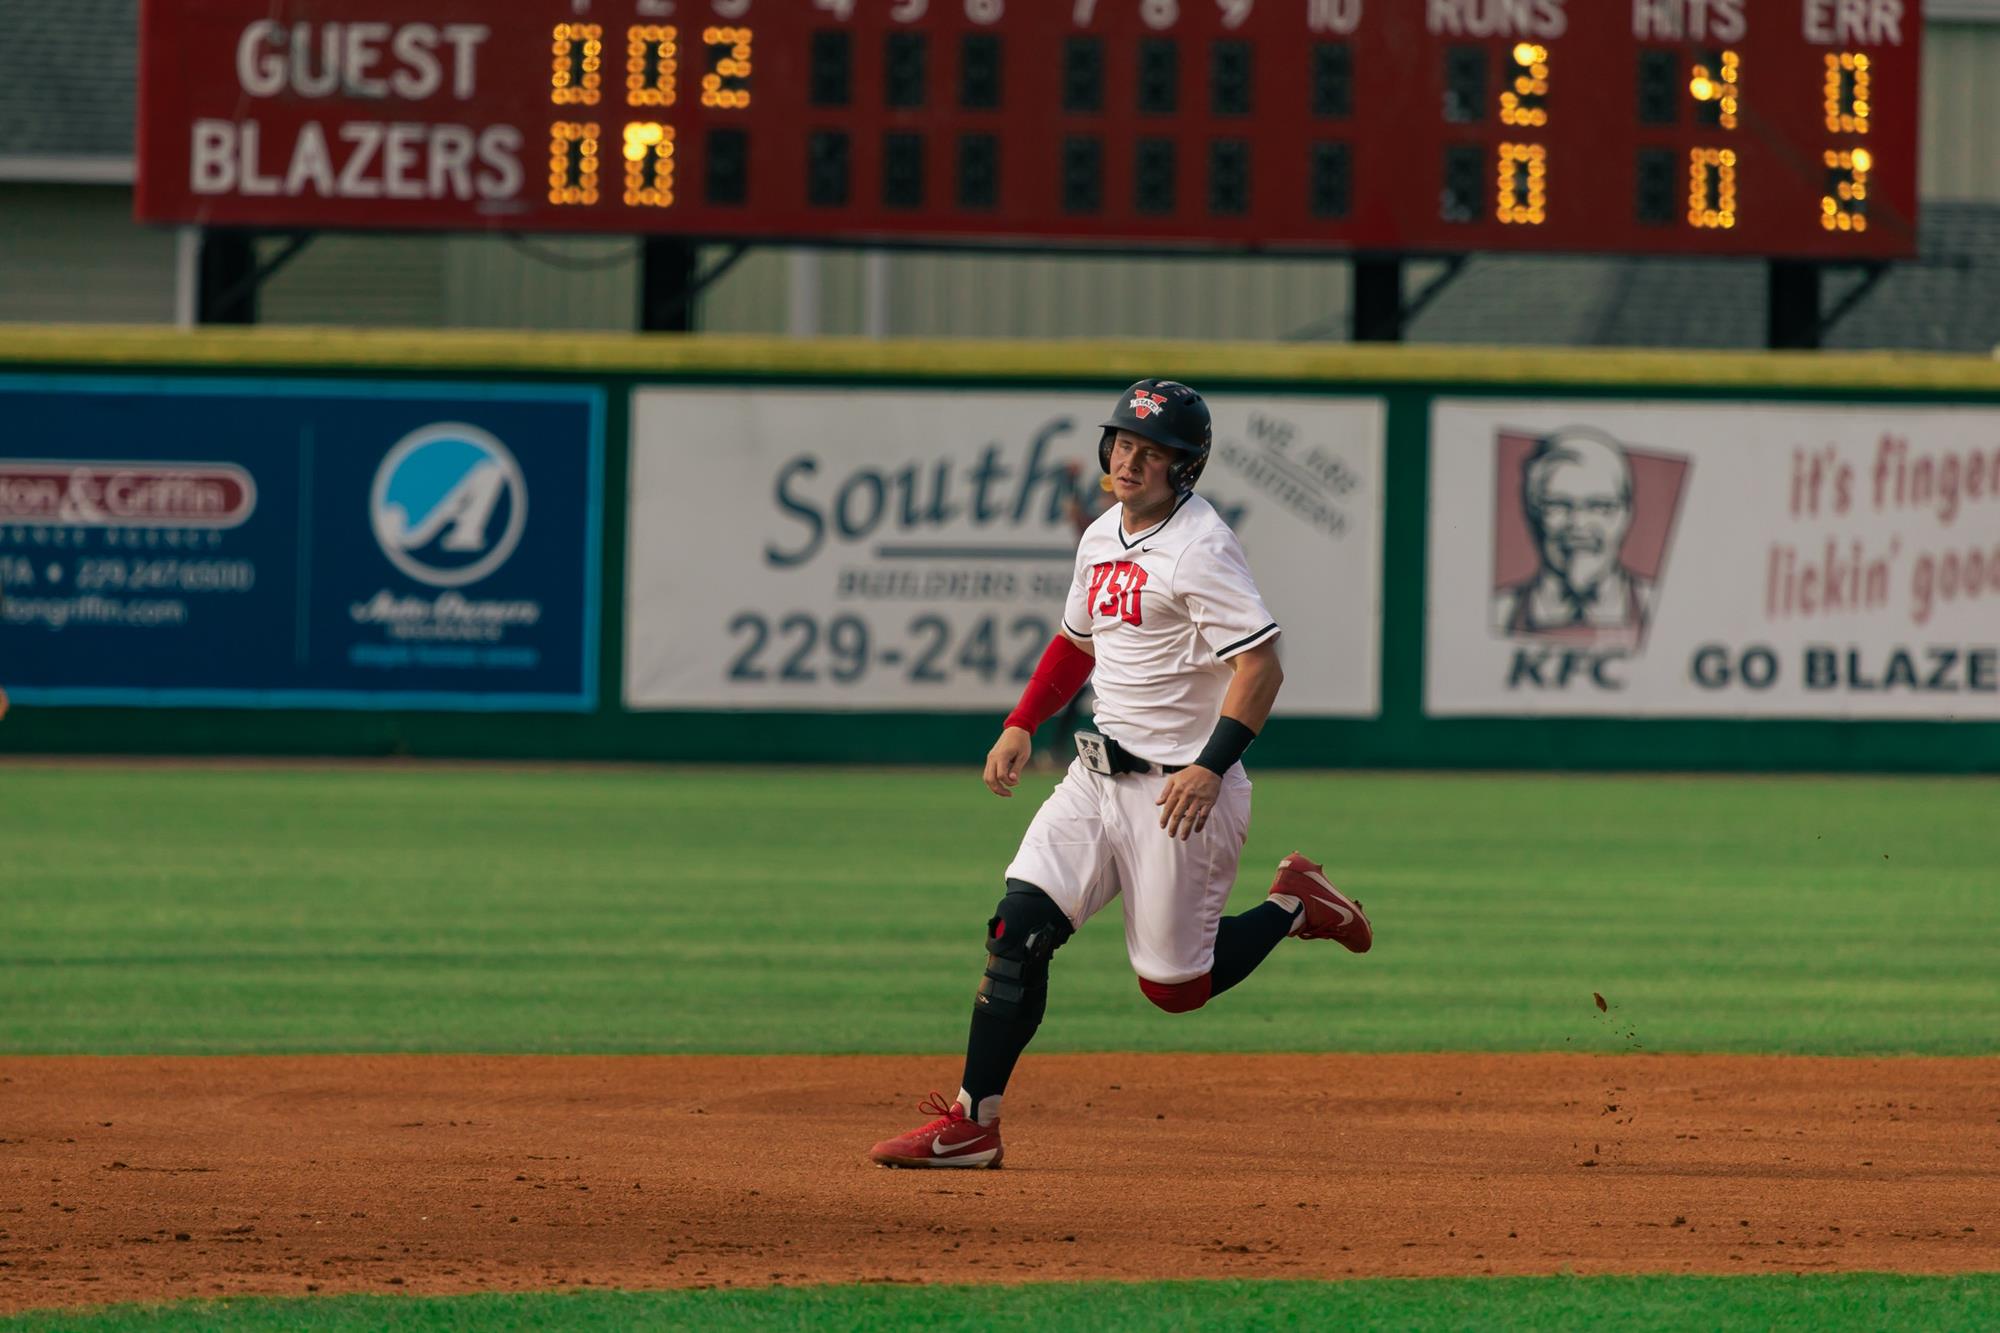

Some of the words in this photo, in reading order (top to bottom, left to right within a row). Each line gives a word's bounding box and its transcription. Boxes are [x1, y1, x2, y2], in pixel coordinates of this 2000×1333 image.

[1426, 0, 1568, 38] RUNS
[1633, 0, 1747, 42] HITS
[1802, 0, 1903, 46] ERR
[236, 18, 490, 99] GUEST
[550, 22, 602, 106] 0
[626, 24, 678, 107] 0
[701, 26, 753, 109] 2
[1499, 42, 1548, 127] 2
[1689, 50, 1739, 130] 4
[1823, 52, 1870, 134] 0
[189, 115, 526, 200] BLAZERS
[548, 120, 600, 206] 0
[623, 121, 675, 208] 0
[1497, 142, 1547, 225] 0
[1688, 146, 1736, 230] 0
[1821, 147, 1873, 232] 2
[1136, 400, 1159, 411] STATE
[1788, 442, 1856, 520] it's
[837, 568, 1022, 601] BUILDERS
[1762, 537, 1902, 622] lickin'
[1504, 646, 1632, 693] KFC
[1690, 644, 1779, 692] GO
[1803, 645, 2000, 694] BLAZE
